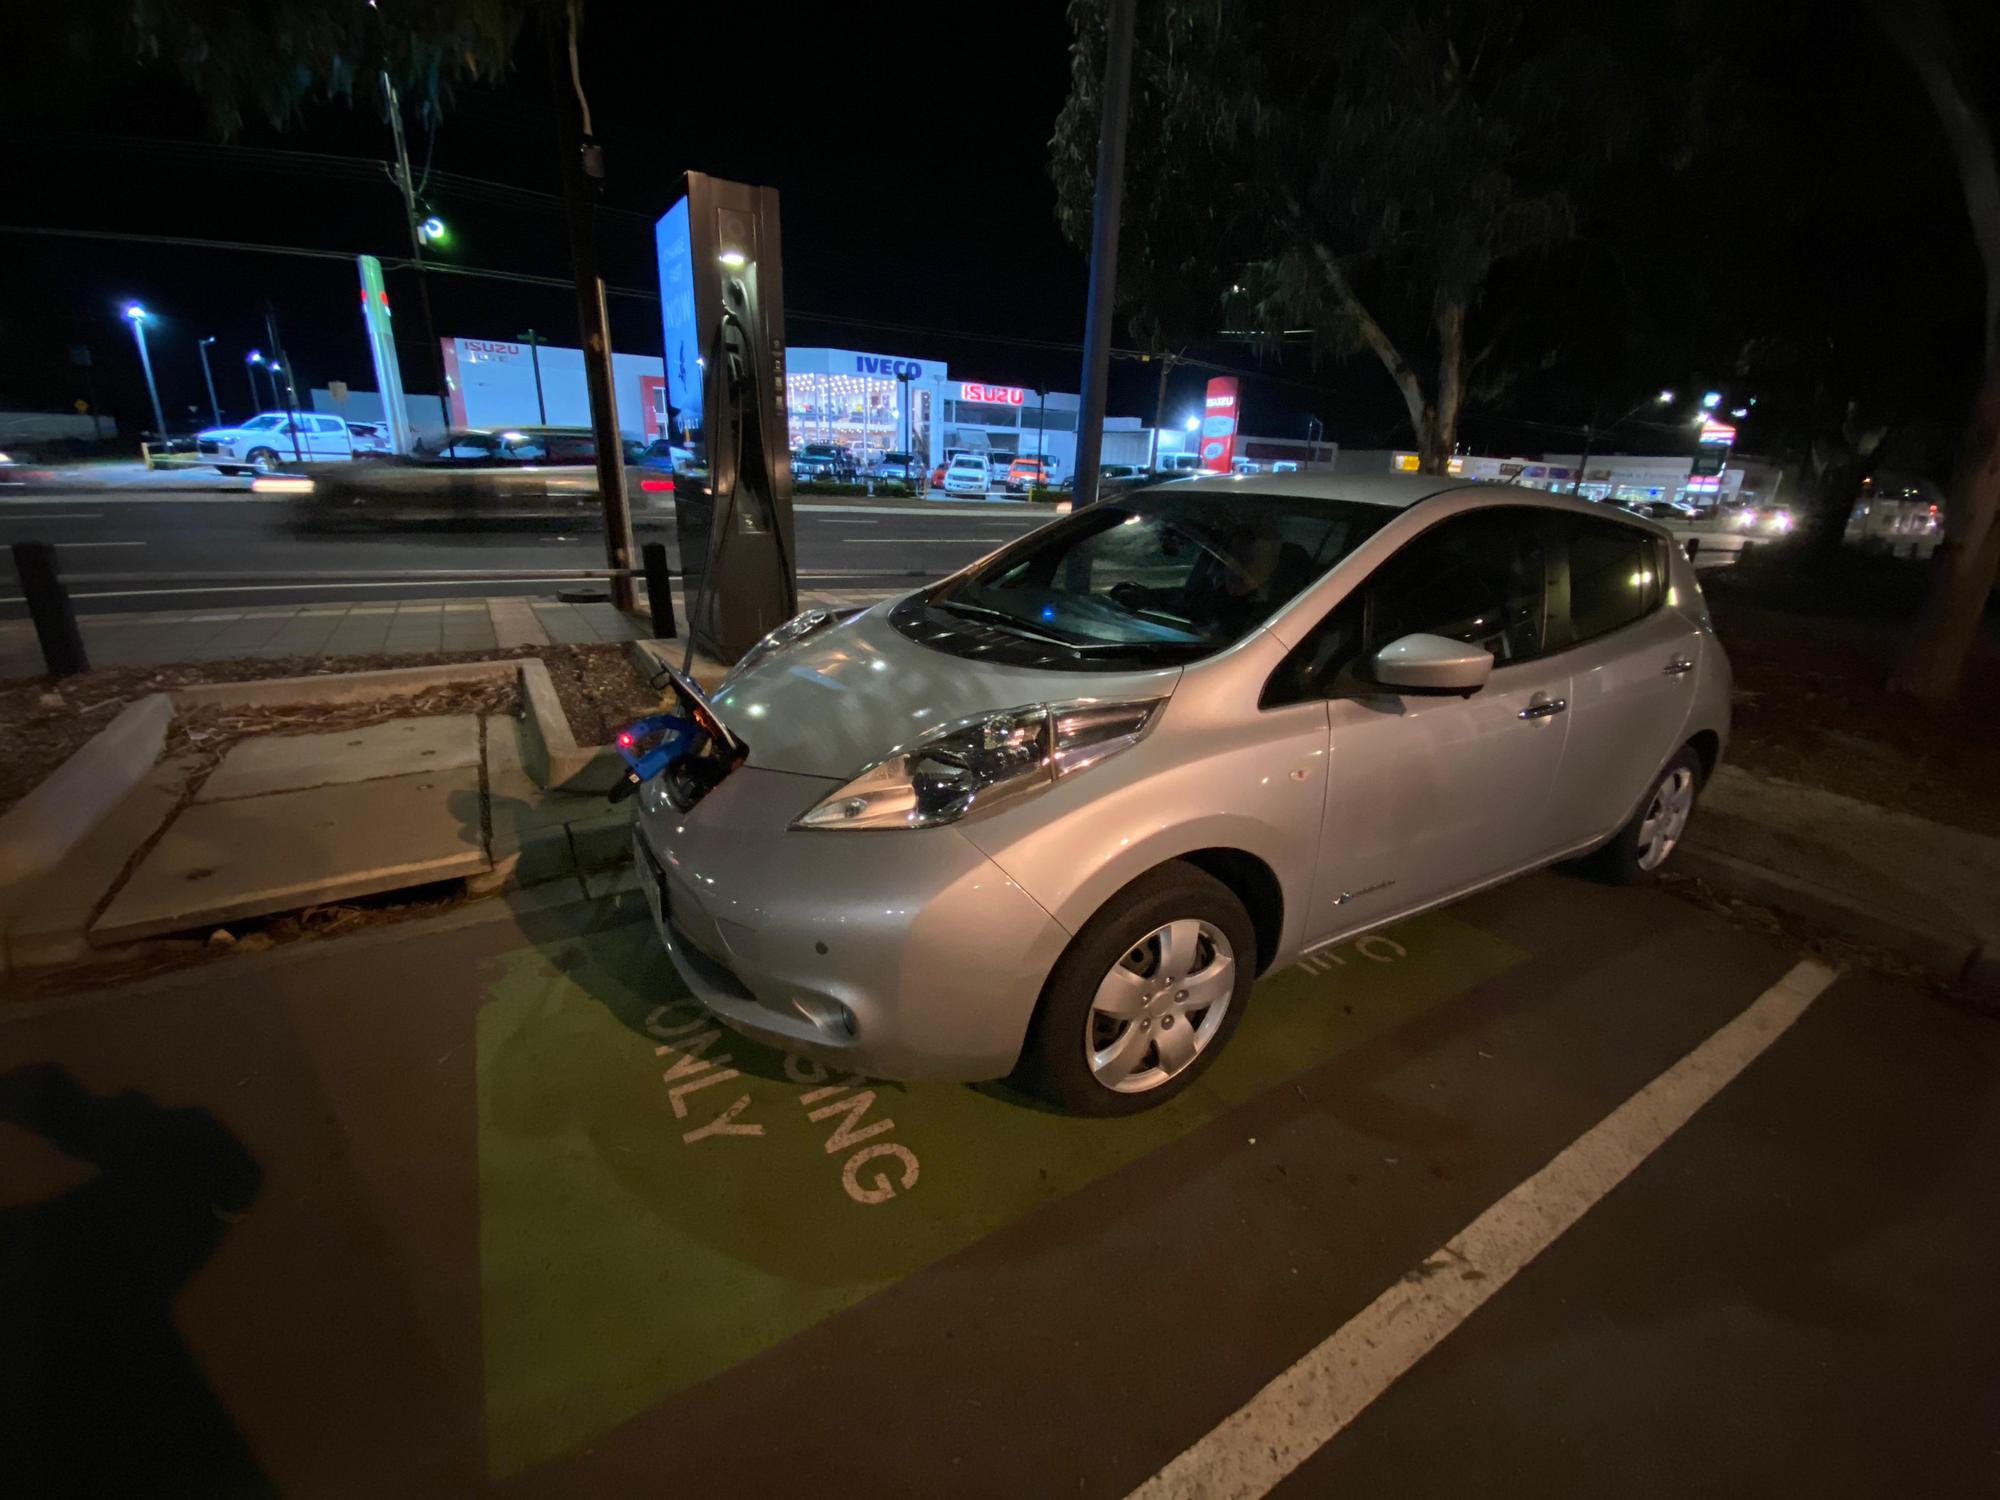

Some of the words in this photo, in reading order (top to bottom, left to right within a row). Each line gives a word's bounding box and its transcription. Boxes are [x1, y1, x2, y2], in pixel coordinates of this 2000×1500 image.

[666, 287, 693, 329] NOW
[464, 341, 519, 355] ISUZU
[856, 356, 922, 379] IVECO
[961, 383, 1024, 406] ISUZU
[645, 999, 767, 1145] ONLY
